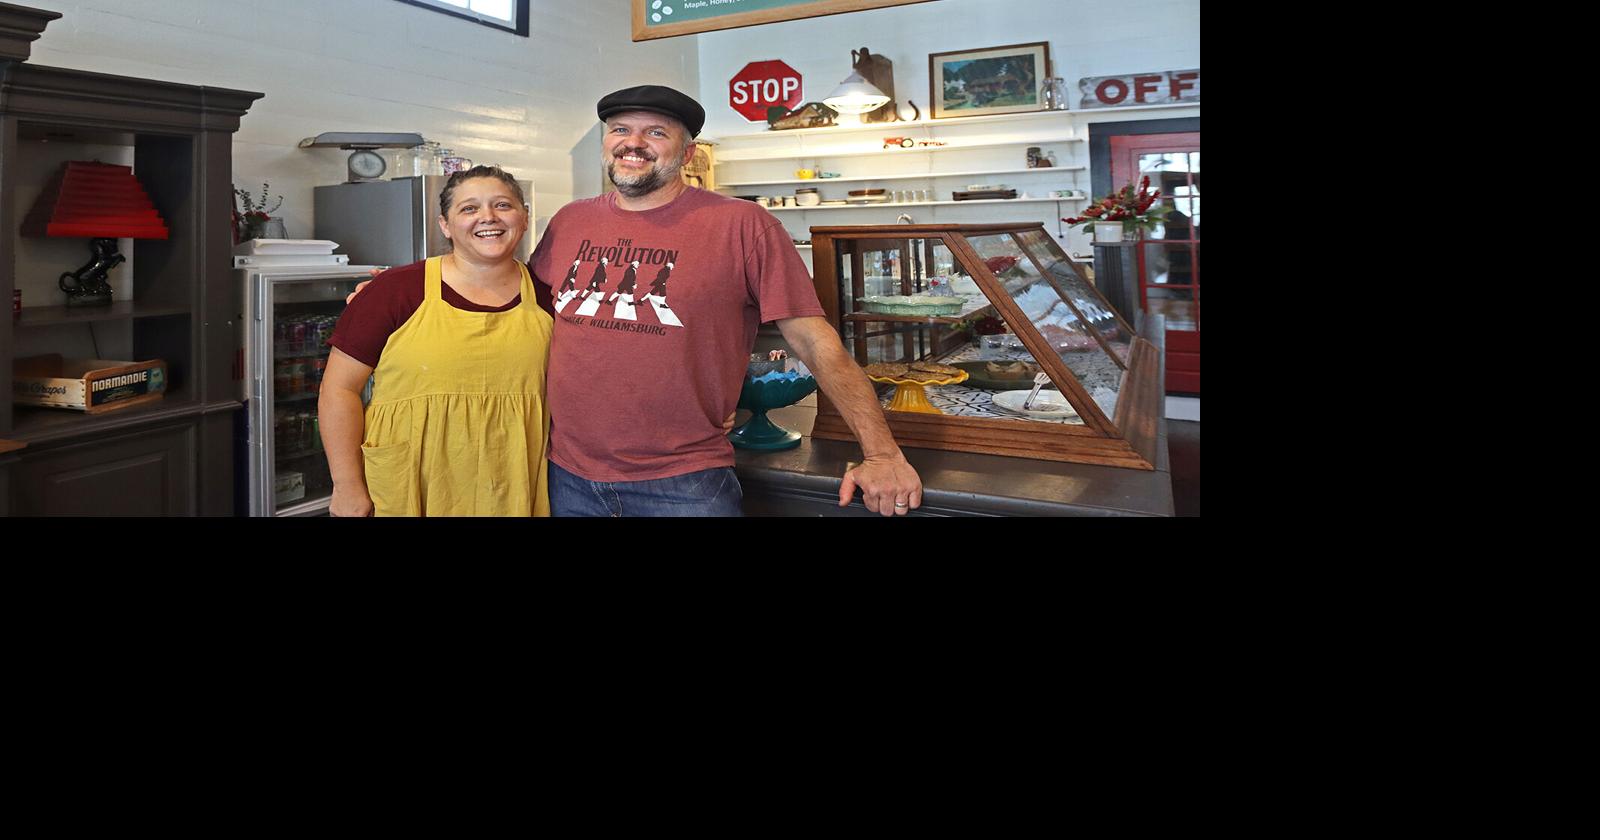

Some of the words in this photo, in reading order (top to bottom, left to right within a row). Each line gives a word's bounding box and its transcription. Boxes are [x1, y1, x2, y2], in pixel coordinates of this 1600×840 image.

[684, 1, 709, 9] Maple,
[733, 77, 799, 105] STOP
[1095, 72, 1198, 105] OFF
[575, 239, 679, 268] REVOLUTION
[617, 238, 633, 247] THE
[589, 319, 667, 336] WILLIAMSBURG
[92, 371, 148, 393] NORMANDIE
